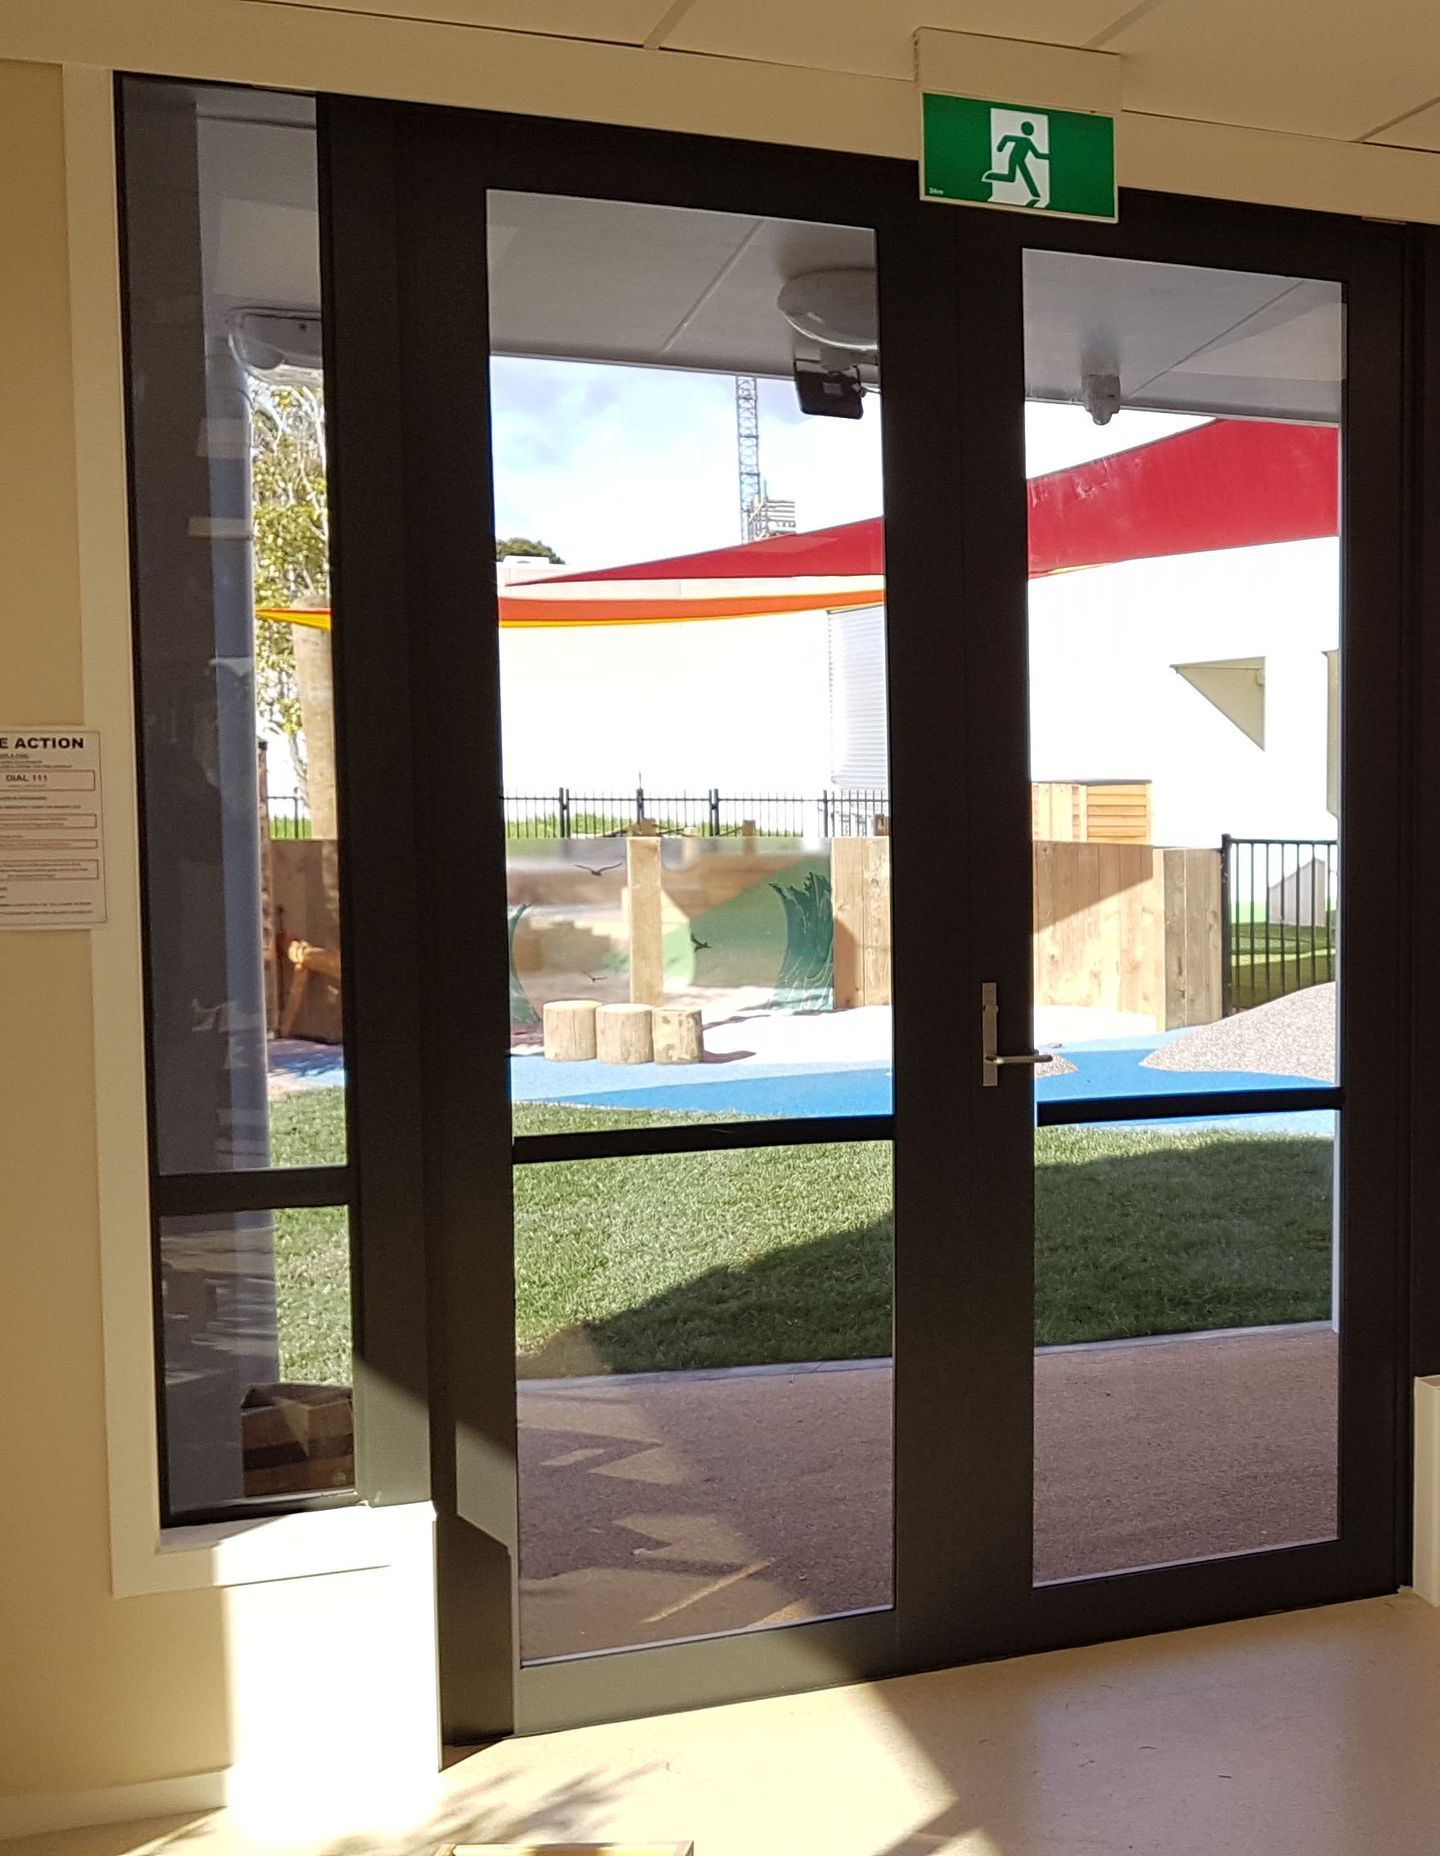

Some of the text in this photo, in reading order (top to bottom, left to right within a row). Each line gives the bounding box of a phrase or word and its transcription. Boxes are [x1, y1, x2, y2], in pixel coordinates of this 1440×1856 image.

[15, 737, 84, 749] ACTION
[5, 774, 48, 782] DIAL 111
